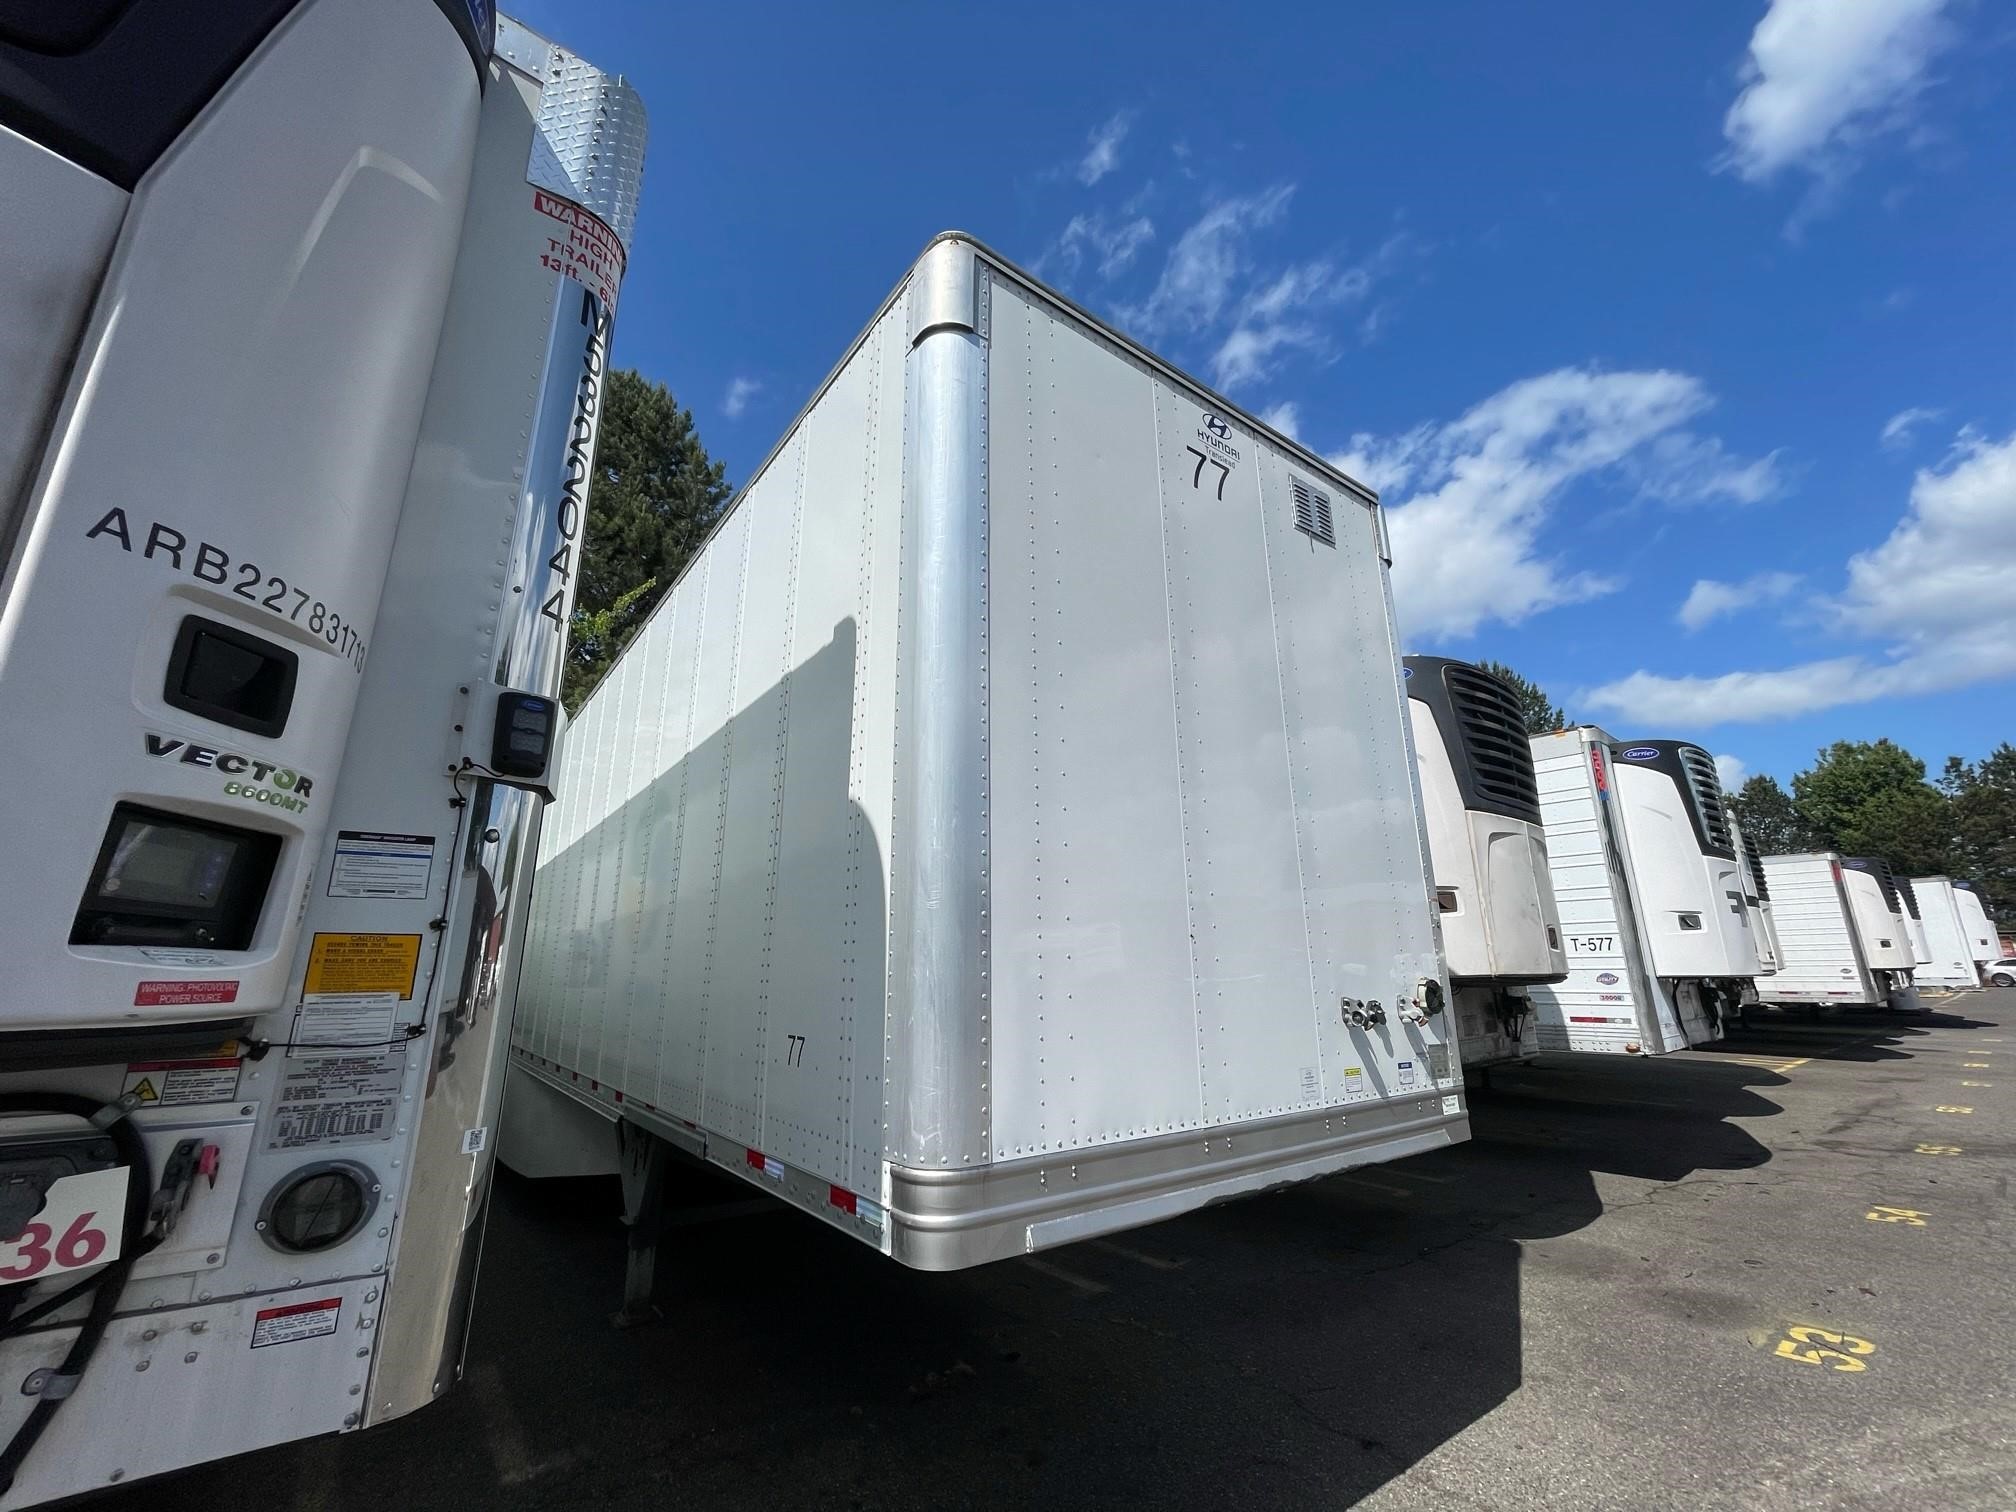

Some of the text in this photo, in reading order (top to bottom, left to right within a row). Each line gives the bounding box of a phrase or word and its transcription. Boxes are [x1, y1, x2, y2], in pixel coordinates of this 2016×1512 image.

[570, 230, 612, 270] HIGH
[1197, 428, 1240, 460] HYUNDAI
[1186, 445, 1230, 501] 77
[86, 507, 367, 675] ARB227831713
[145, 733, 314, 798] VECTOR
[1627, 750, 1655, 758] Carrier
[223, 781, 309, 814] 8600MT
[1570, 937, 1613, 952] T-577
[160, 993, 222, 1004] POWER SOURCE
[787, 1034, 806, 1068] 77
[1774, 1326, 1877, 1373] 53
